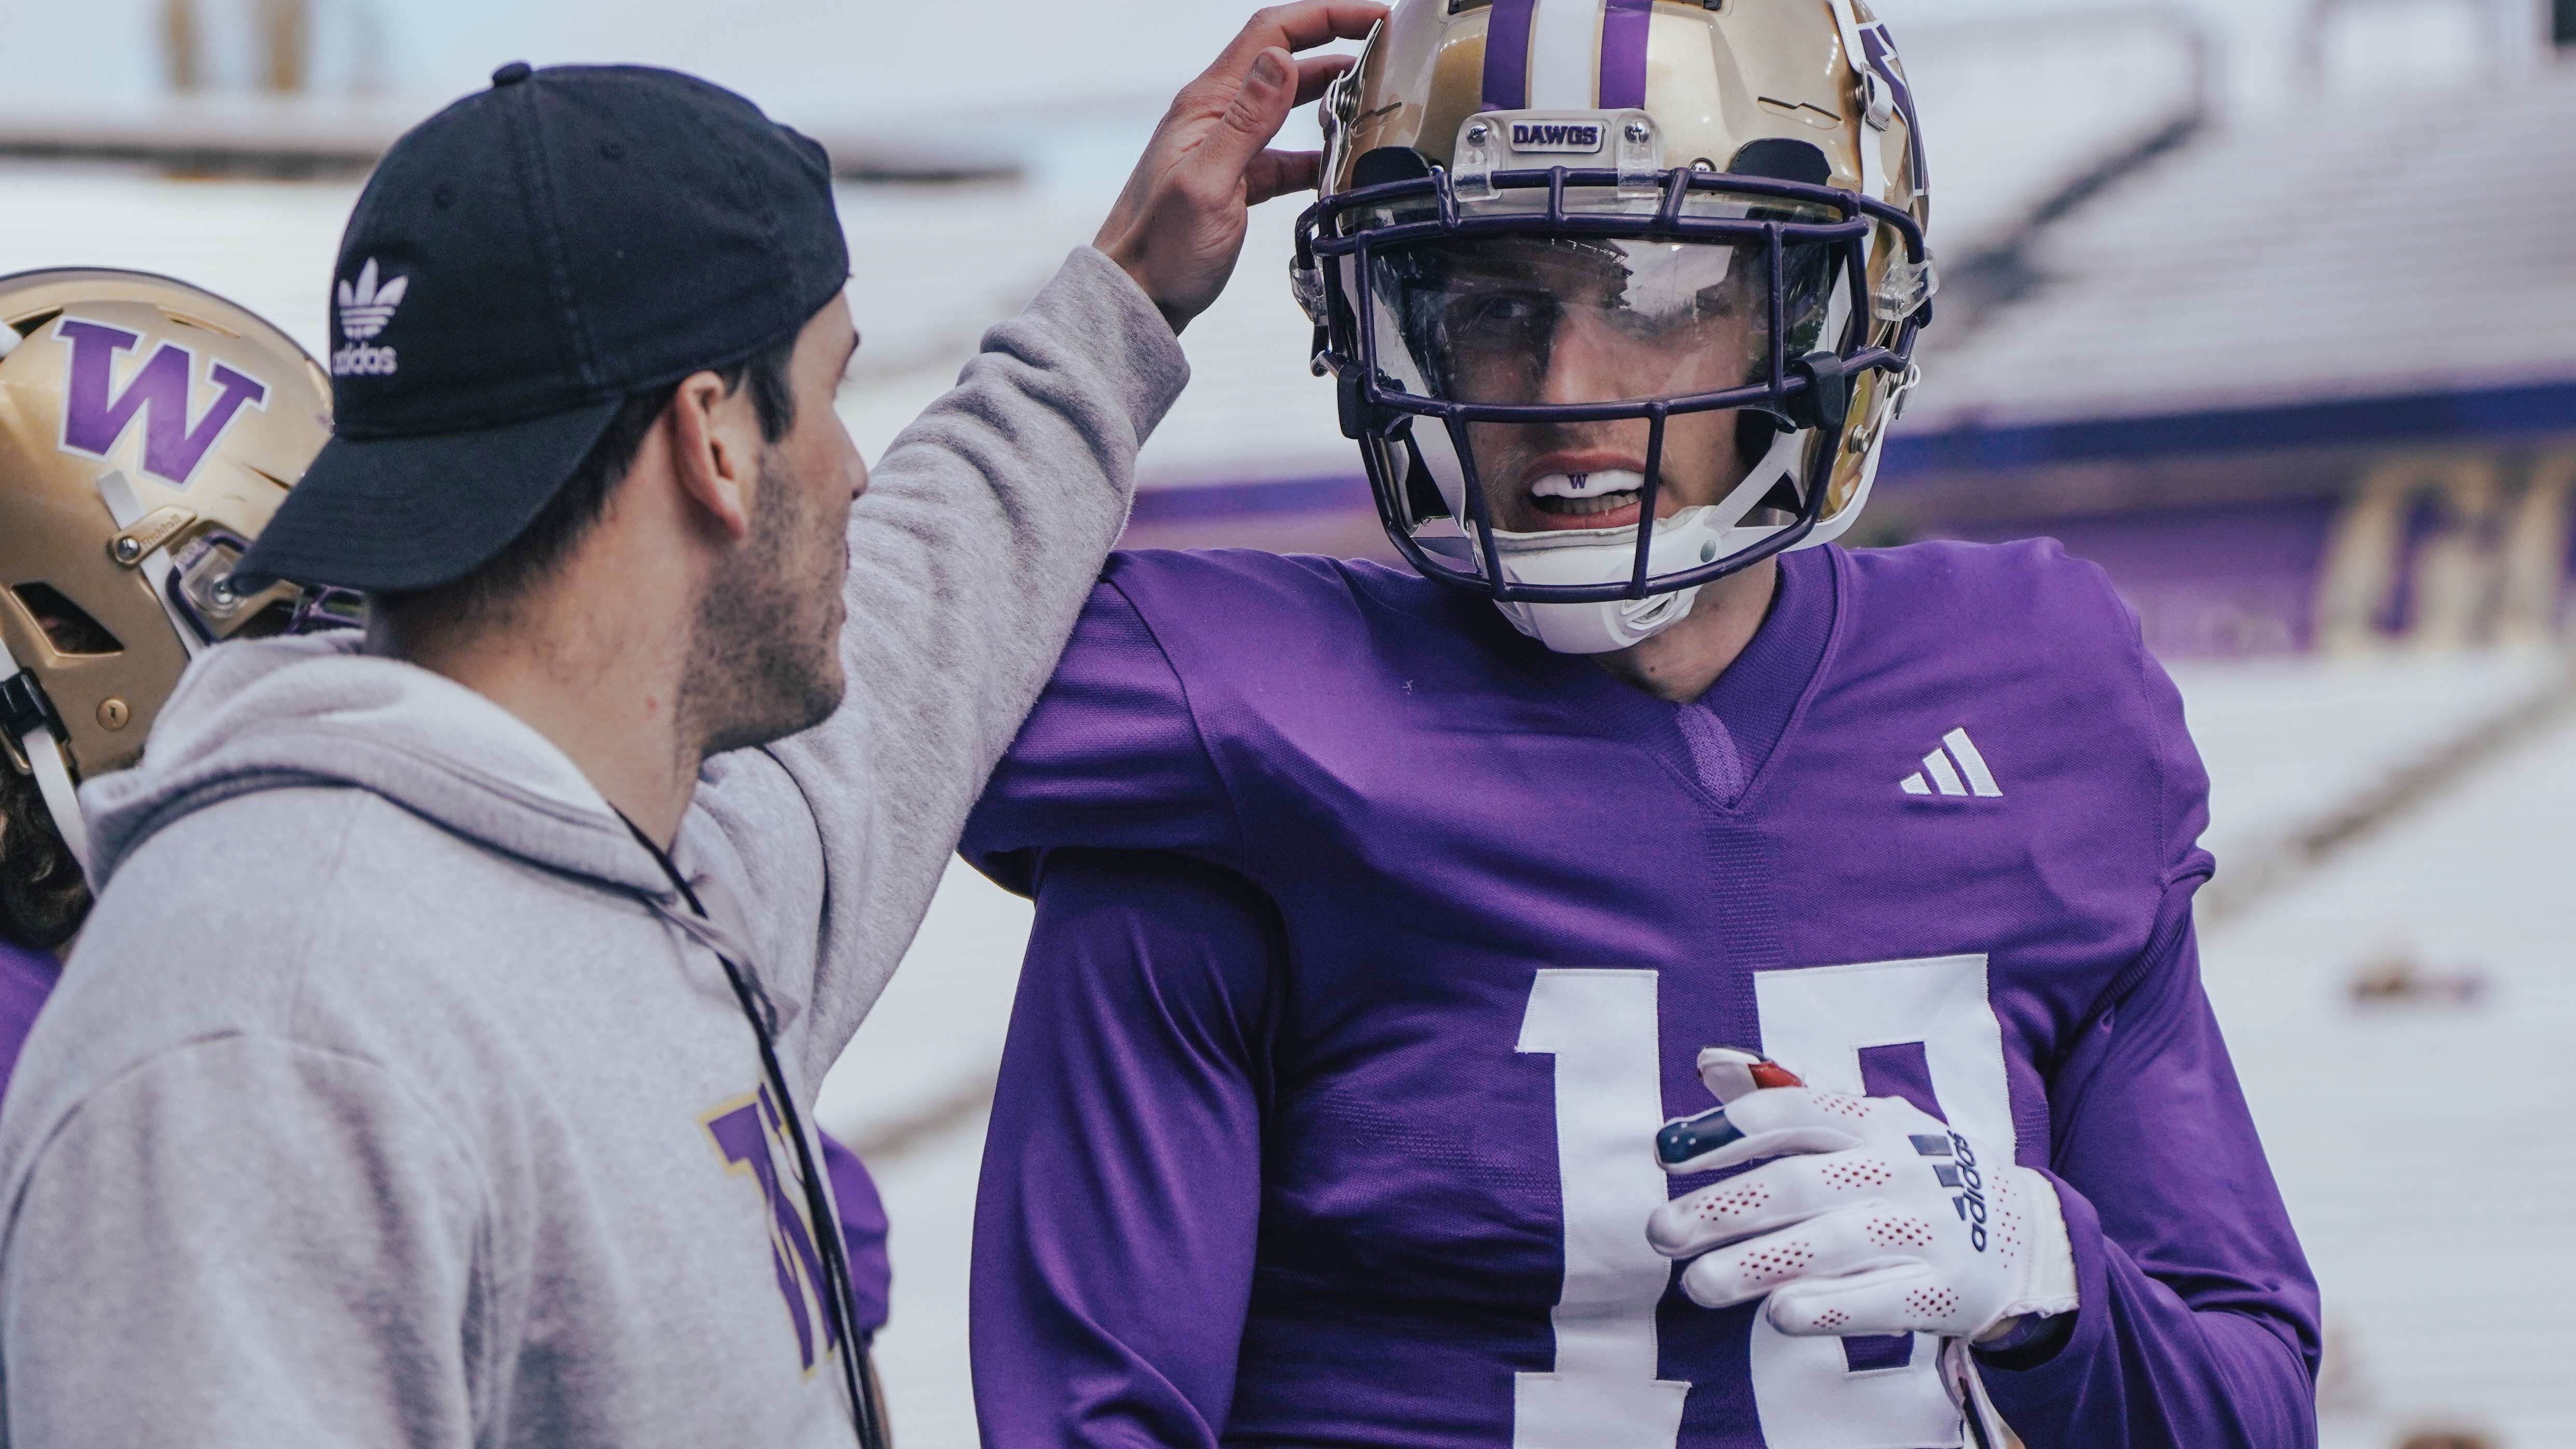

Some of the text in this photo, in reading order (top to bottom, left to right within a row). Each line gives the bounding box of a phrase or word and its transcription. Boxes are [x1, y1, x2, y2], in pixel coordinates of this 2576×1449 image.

[1513, 124, 1597, 144] DAWGS
[52, 317, 271, 491] W
[1567, 473, 1589, 489] W
[1947, 1129, 1987, 1252] adidas
